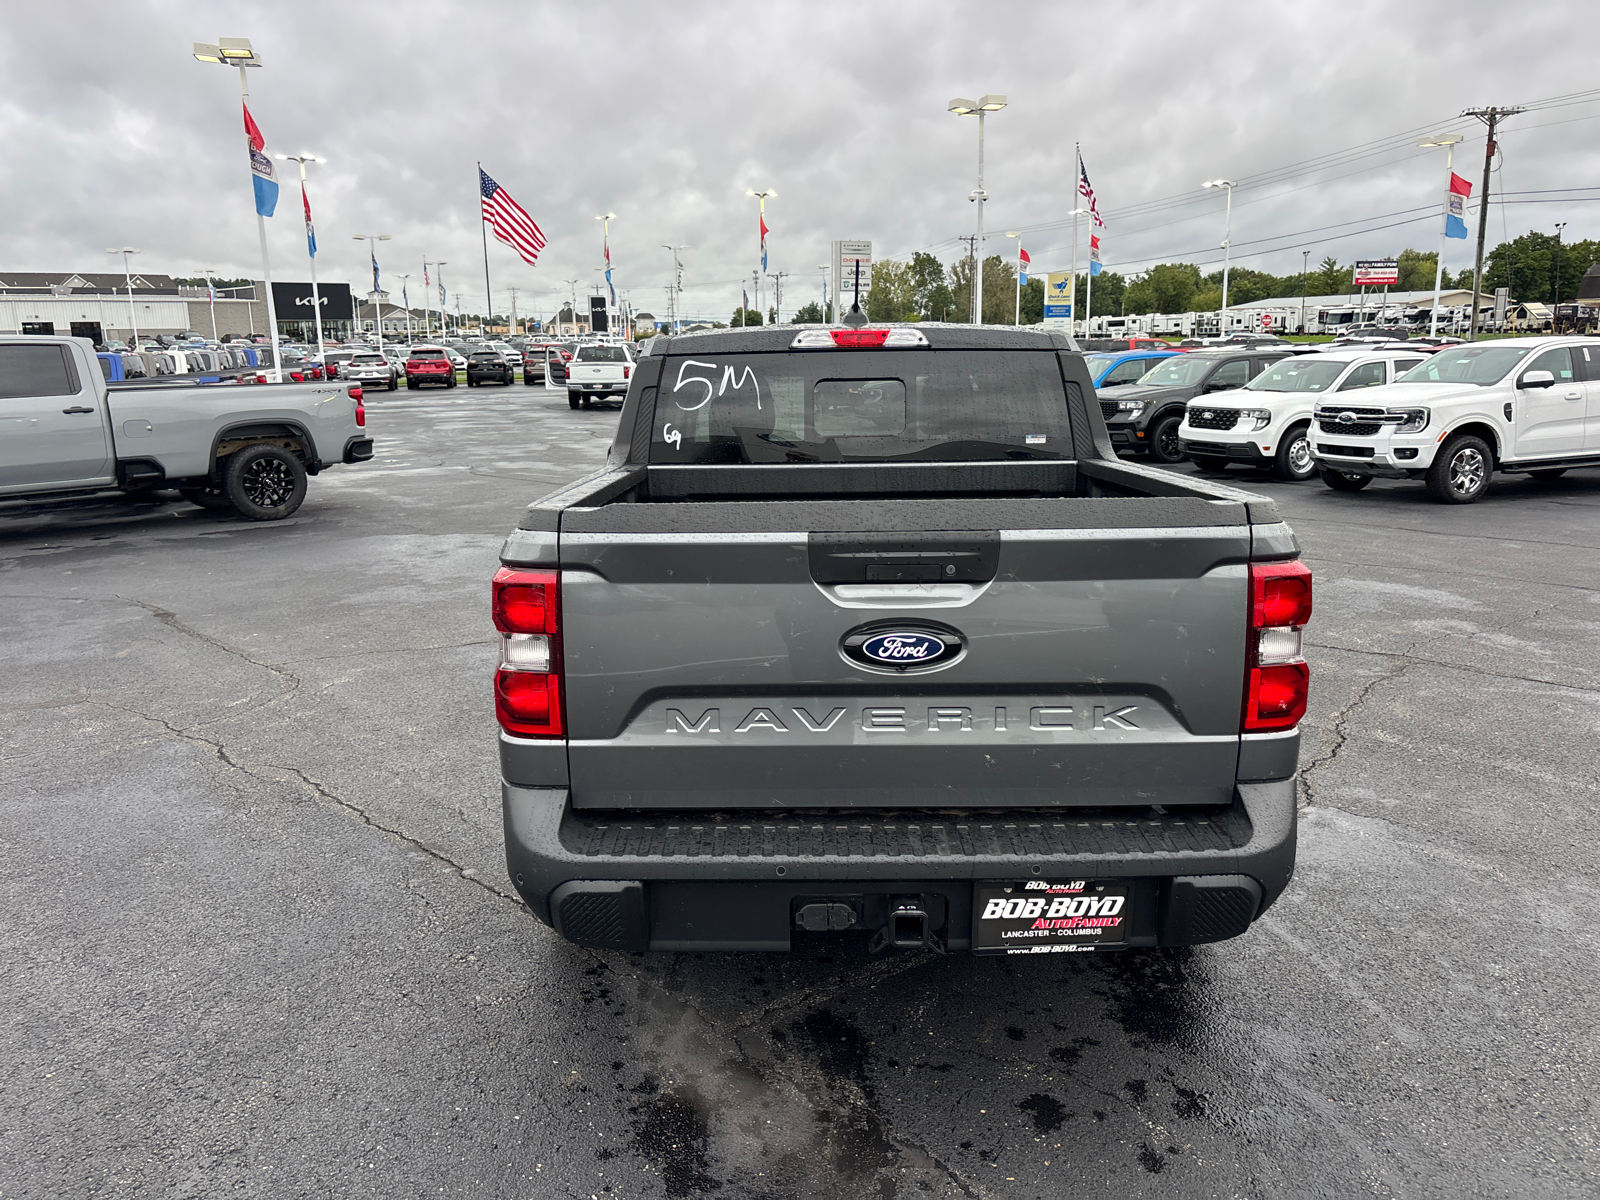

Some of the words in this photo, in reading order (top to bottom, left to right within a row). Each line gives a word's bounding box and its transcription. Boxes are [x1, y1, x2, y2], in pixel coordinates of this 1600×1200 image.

[251, 161, 272, 175] OUGH
[878, 636, 929, 658] Ford
[665, 706, 1141, 732] MAVERICK
[1002, 930, 1050, 938] LANCASTER
[1057, 928, 1102, 937] COLUMBUS
